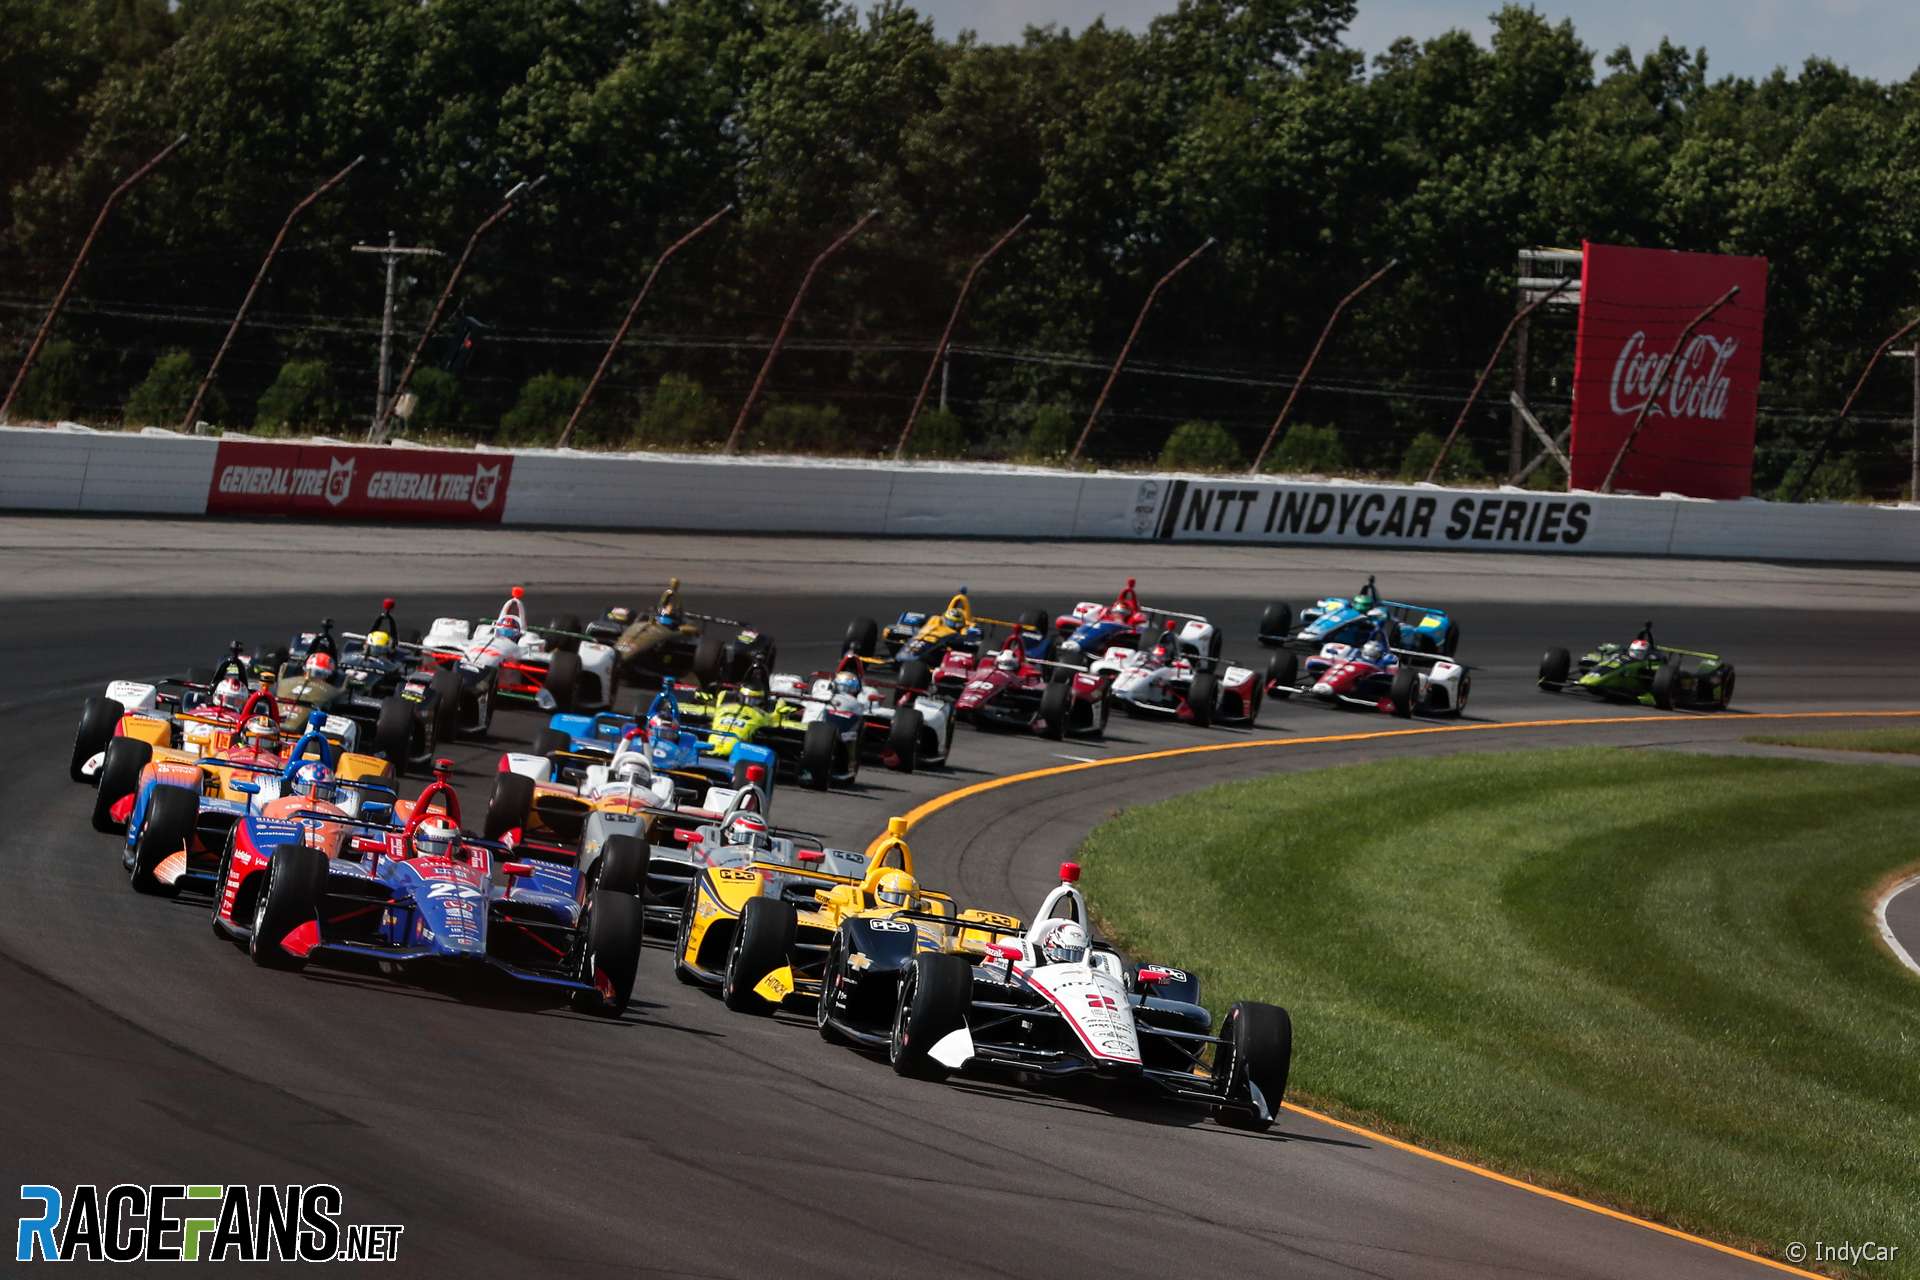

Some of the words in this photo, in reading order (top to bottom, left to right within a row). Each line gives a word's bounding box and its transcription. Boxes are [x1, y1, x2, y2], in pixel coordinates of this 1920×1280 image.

[218, 465, 289, 494] GENERAL
[286, 468, 328, 496] TIRE
[367, 471, 438, 500] GENERAL
[436, 474, 474, 501] TIRE
[1182, 487, 1260, 533] NTT
[1264, 490, 1438, 540] INDYCAR
[1445, 497, 1592, 545] SERIES
[721, 870, 756, 880] PPG
[872, 919, 909, 932] PPG
